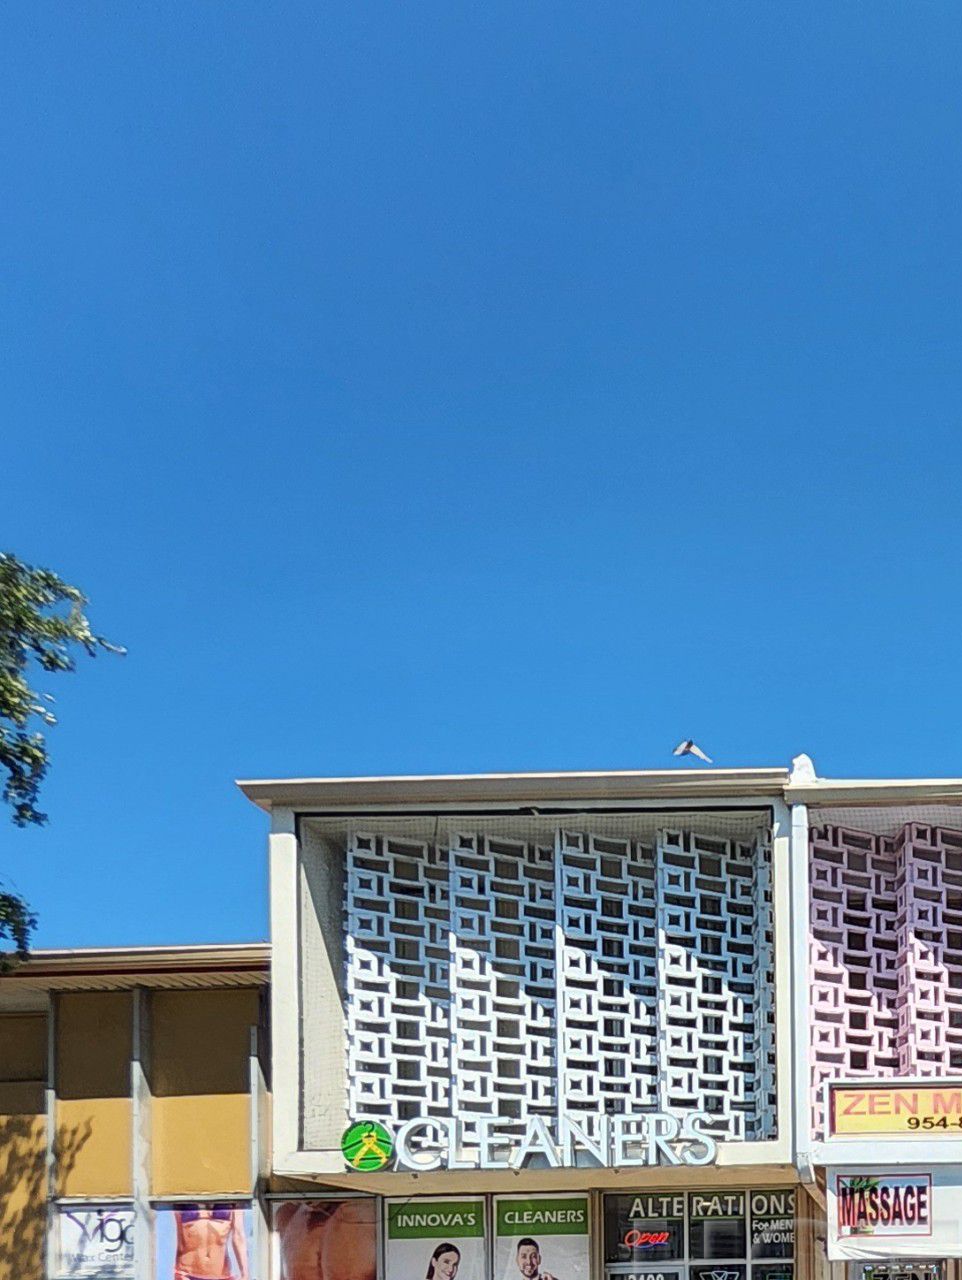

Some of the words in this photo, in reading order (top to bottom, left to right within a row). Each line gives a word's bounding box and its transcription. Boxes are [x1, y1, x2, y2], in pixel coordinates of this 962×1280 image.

[842, 1092, 919, 1115] ZEN
[394, 1114, 718, 1171] CLEANERS
[841, 1185, 929, 1226] MASSAGE
[397, 1212, 476, 1228] INNOVA'S
[504, 1209, 585, 1225] CLEANERS
[752, 1220, 769, 1231] For
[770, 1219, 795, 1231] MEN
[624, 1228, 670, 1248] Open
[752, 1234, 761, 1244] &
